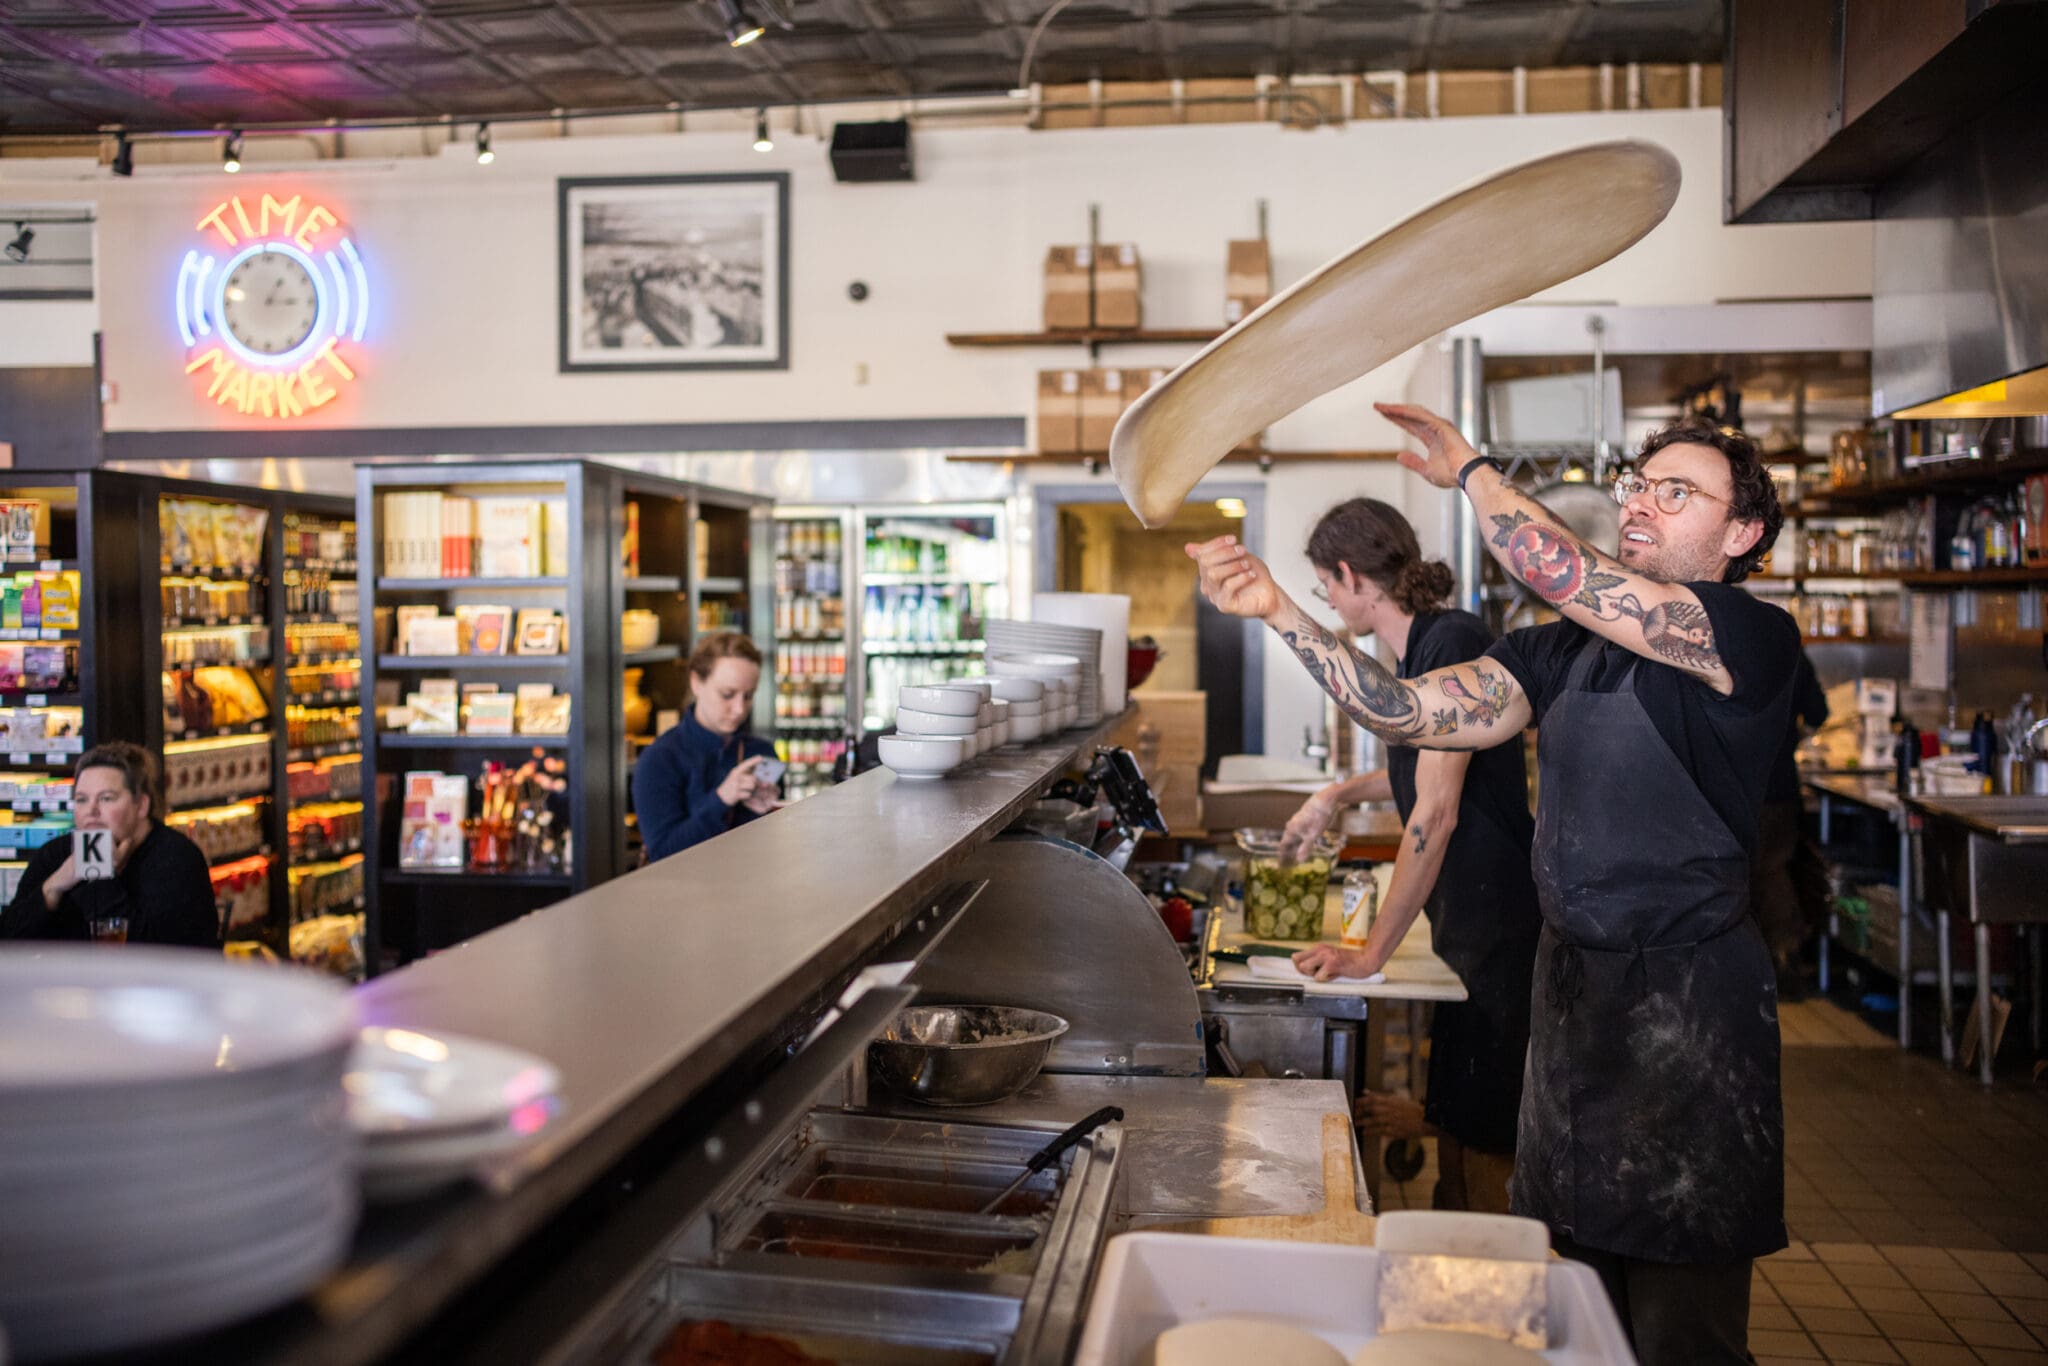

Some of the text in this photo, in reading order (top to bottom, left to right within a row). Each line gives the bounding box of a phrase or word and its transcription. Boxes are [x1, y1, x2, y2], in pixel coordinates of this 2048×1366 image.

[197, 194, 338, 252] TIME
[185, 336, 355, 418] MARKET
[82, 832, 105, 864] K
